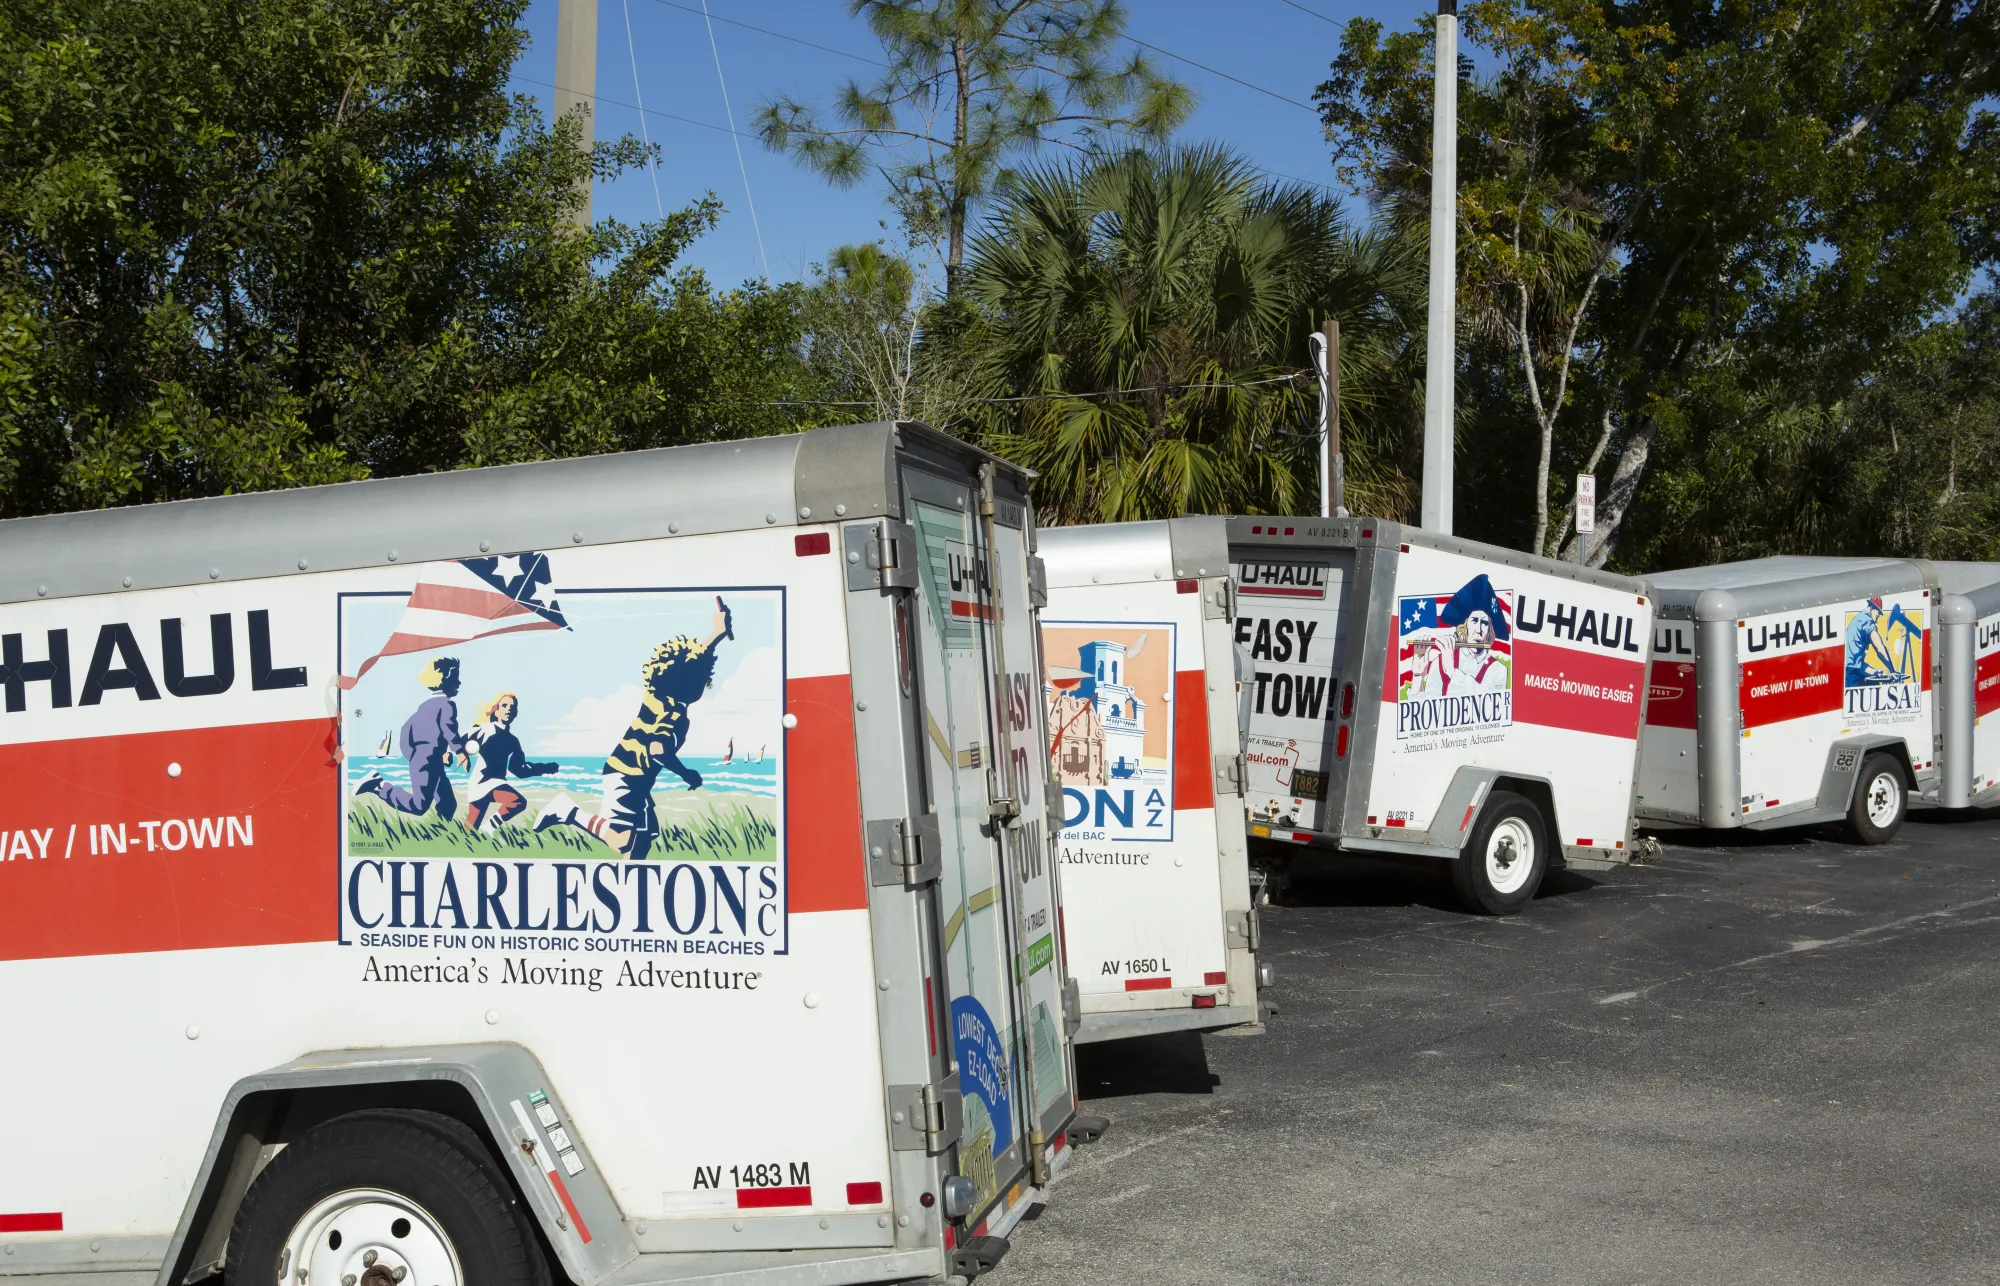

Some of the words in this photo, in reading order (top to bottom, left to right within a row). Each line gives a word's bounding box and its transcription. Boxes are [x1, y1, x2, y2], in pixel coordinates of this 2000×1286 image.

[1582, 481, 1590, 492] NO
[1308, 528, 1318, 537] AV
[1321, 528, 1340, 538] 8221
[1343, 529, 1348, 538] B
[1241, 564, 1324, 587] U-HAUL
[1516, 595, 1639, 653] U-HAUL
[1748, 615, 1837, 652] U-HAUL
[1234, 617, 1318, 663] EASY
[0, 609, 308, 713] HAUL
[1255, 672, 1338, 721] TOW!
[1524, 674, 1558, 691] MAKES
[1561, 680, 1600, 698] MOVING
[1602, 688, 1633, 703] EASIER
[1750, 681, 1788, 698] ONE-WAY
[1794, 674, 1829, 690] IN-TOWN
[1845, 684, 1912, 713] TULSA
[1399, 692, 1502, 732] PROVIDENCE
[1404, 740, 1438, 753] America's
[1440, 737, 1467, 749] Moving
[1470, 733, 1505, 745] Adventure
[1388, 810, 1395, 819] AV
[1396, 811, 1408, 820] 8221
[1410, 812, 1414, 820] B
[90, 815, 254, 856] IN-TOWN
[1064, 832, 1080, 840] del
[1082, 832, 1106, 840] BAC
[1059, 848, 1150, 866] Adventure
[348, 860, 750, 936] CHARLESTON
[360, 933, 428, 948] SEASIDE
[434, 934, 466, 948] FUN
[472, 936, 496, 950] ON
[501, 936, 579, 951] HISTORIC
[584, 938, 678, 954] SOUTHERN
[684, 940, 764, 956] BEACHES
[362, 956, 488, 984] America's
[501, 958, 604, 992] Moving
[1101, 960, 1120, 976] AV
[1124, 958, 1158, 974] 1650
[1162, 957, 1171, 972] L
[958, 1012, 985, 1048] LOWEST
[693, 1166, 722, 1189] AV
[730, 1163, 782, 1188] 1483
[789, 1162, 810, 1186] M
